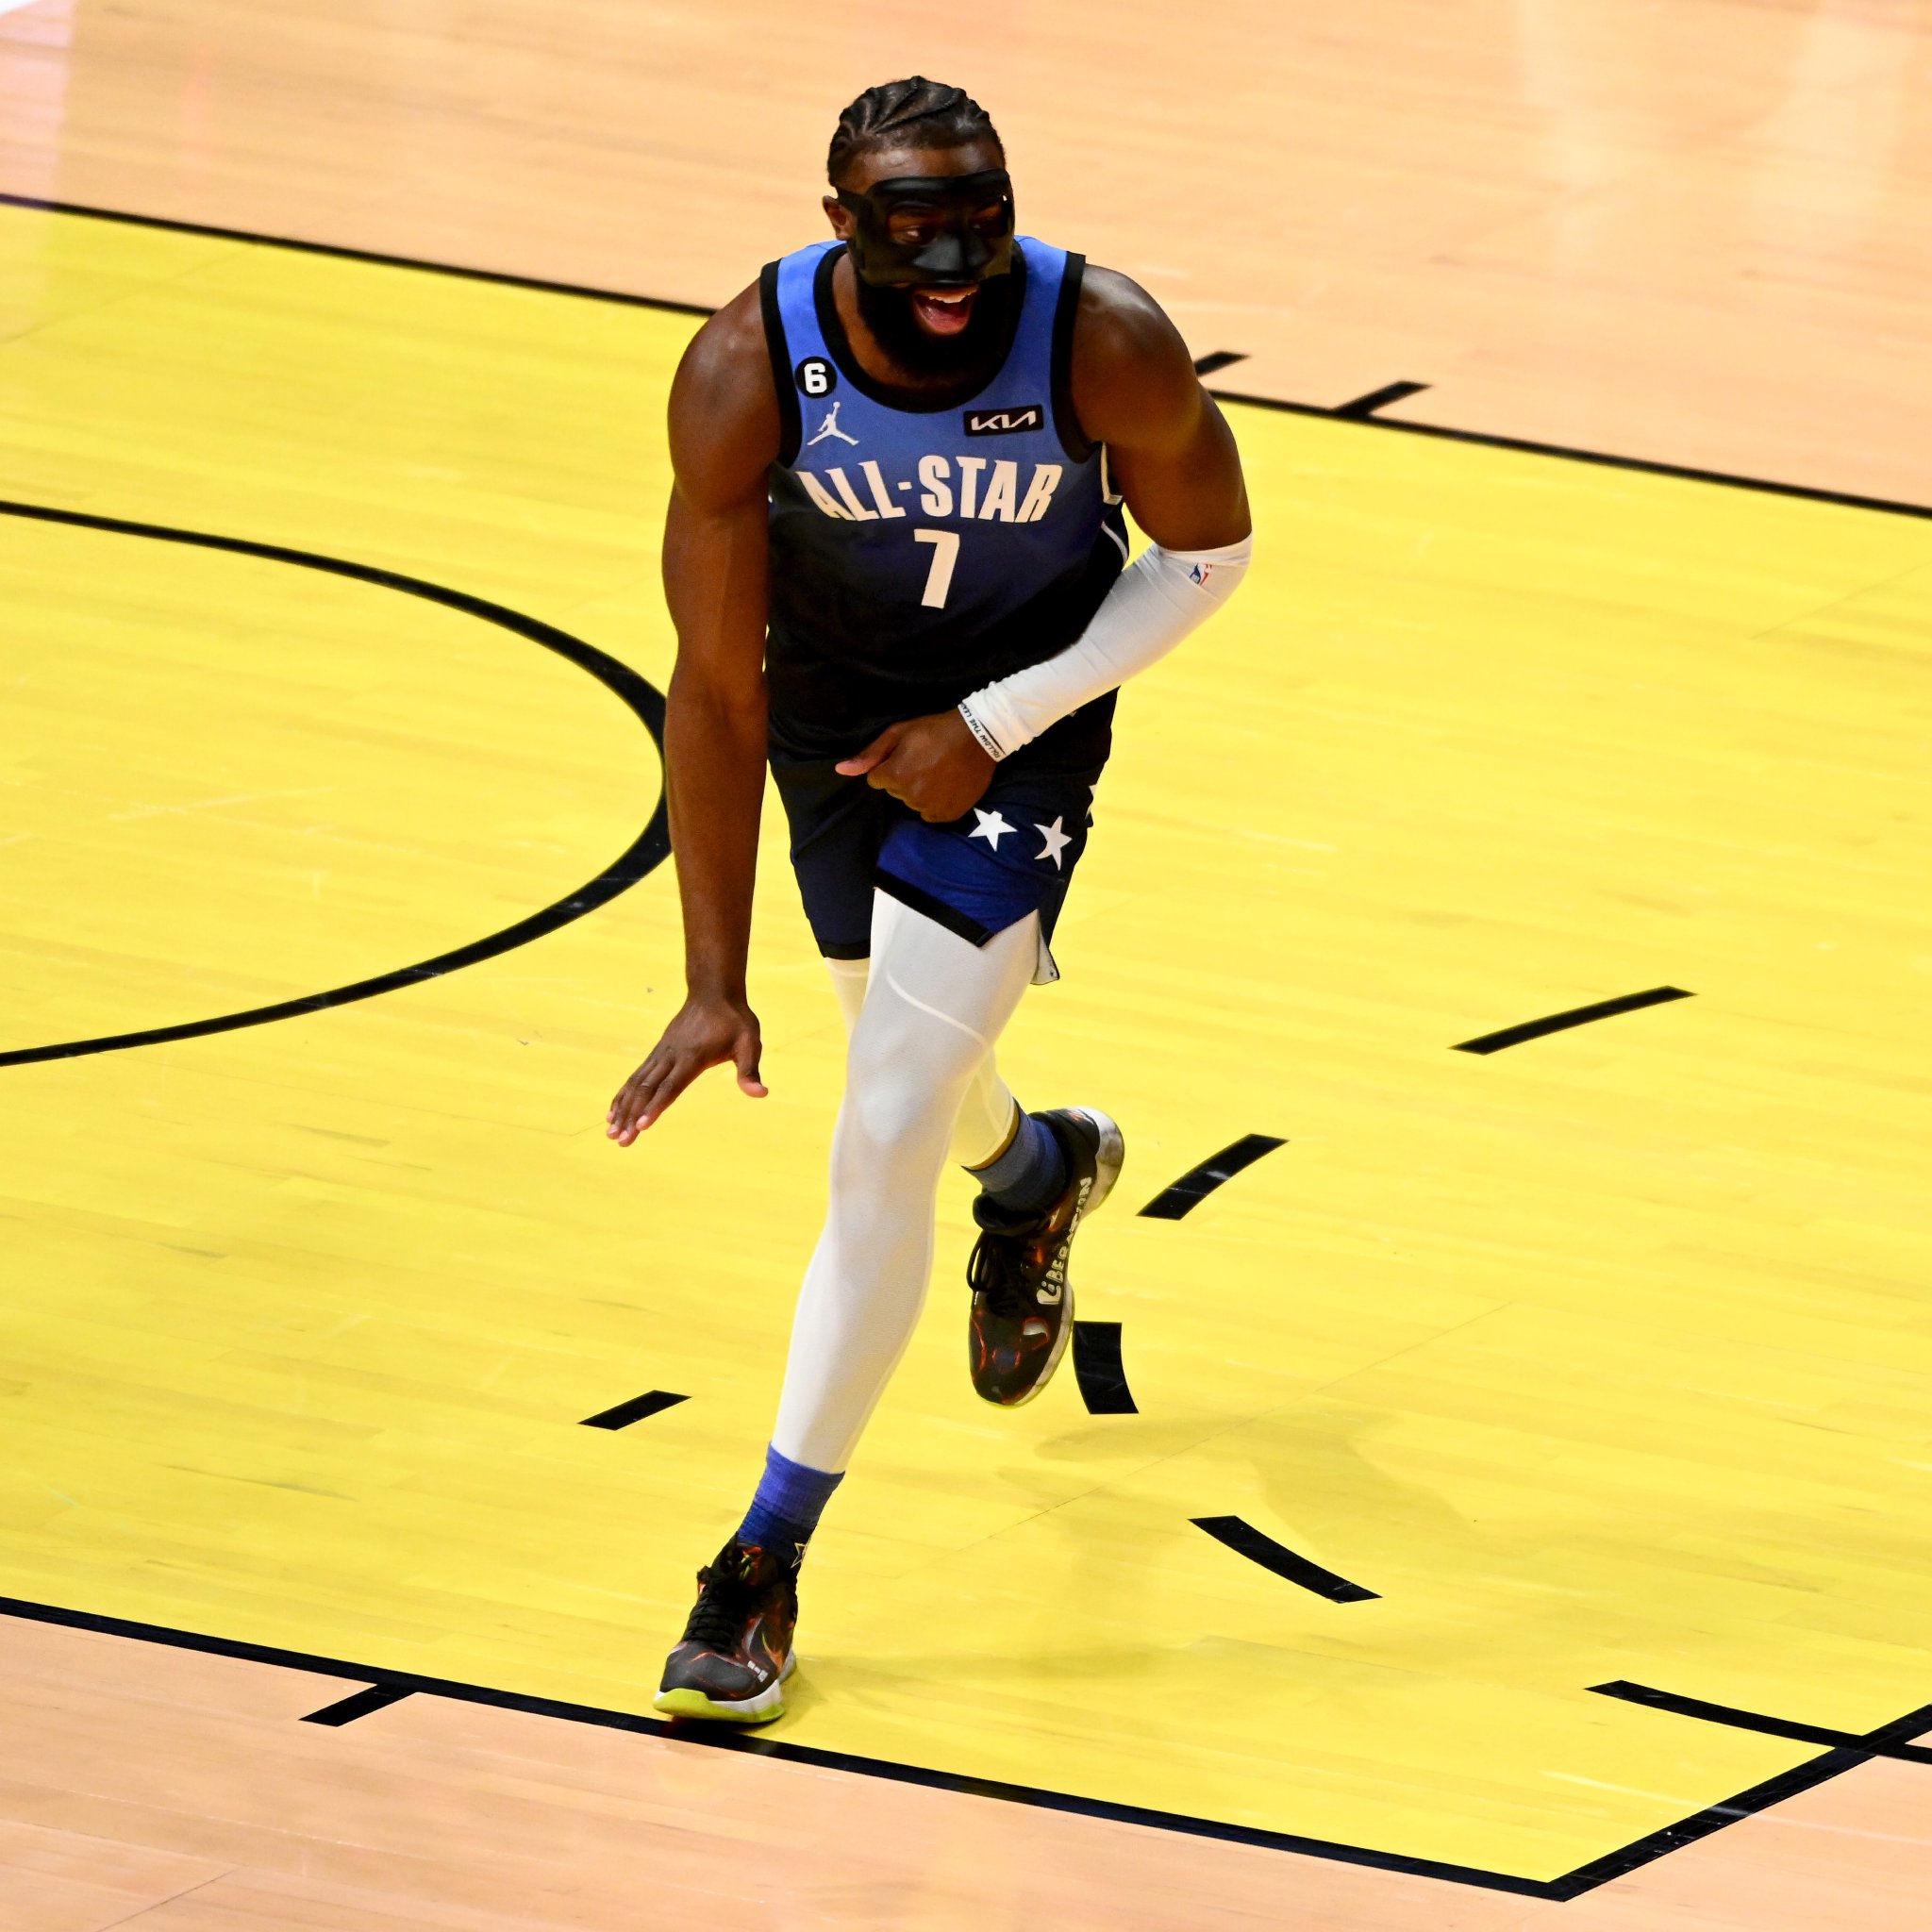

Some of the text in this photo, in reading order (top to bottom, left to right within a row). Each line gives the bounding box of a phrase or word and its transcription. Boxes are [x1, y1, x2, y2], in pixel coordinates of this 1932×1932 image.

[803, 361, 827, 394] 6
[970, 409, 1037, 431] KIA
[794, 454, 1063, 524] ALL-STAR
[913, 527, 960, 609] 7
